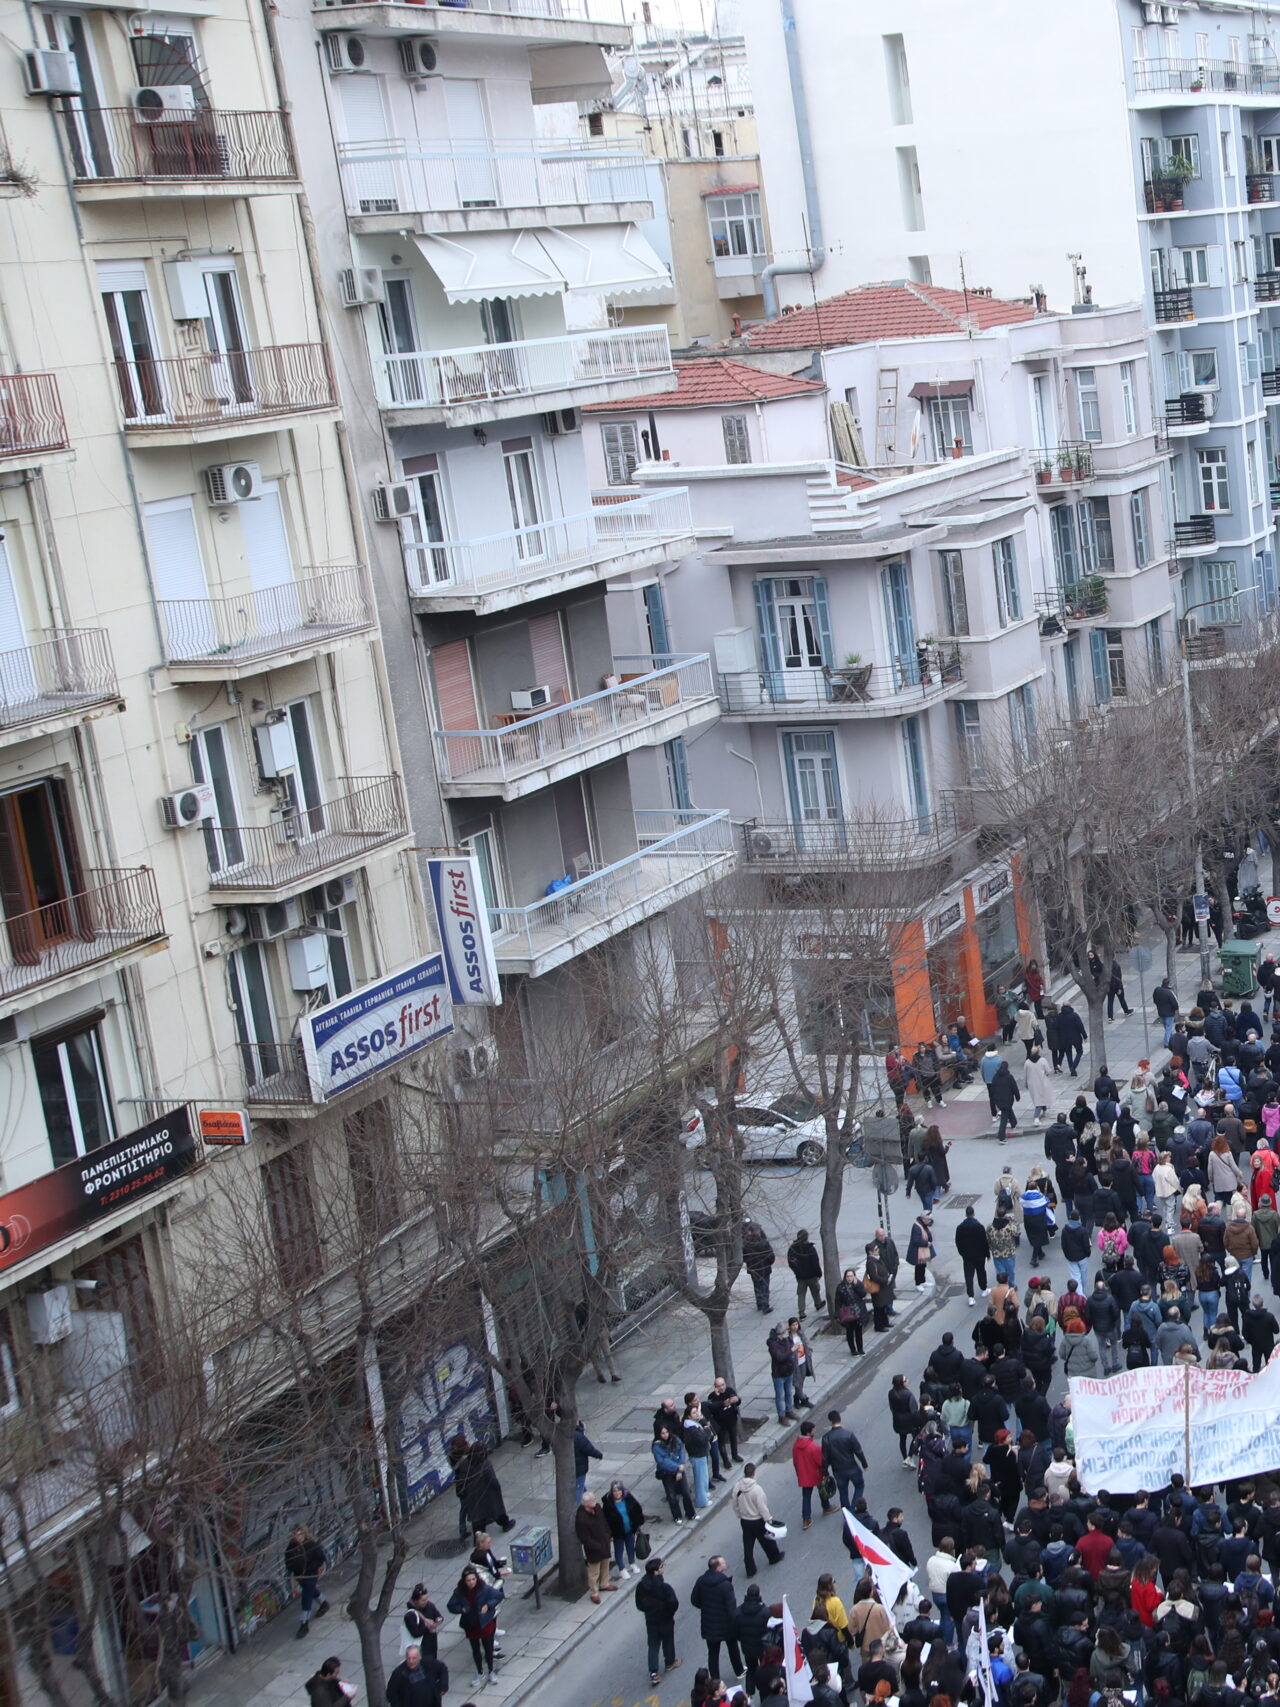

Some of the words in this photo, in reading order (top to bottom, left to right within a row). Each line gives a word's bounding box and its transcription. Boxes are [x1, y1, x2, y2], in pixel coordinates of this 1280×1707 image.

[448, 869, 476, 920] first
[460, 920, 484, 994] ASSOS
[330, 1020, 397, 1077] ASSOS
[398, 993, 441, 1048] first
[81, 1129, 169, 1181] ΠΑΝΕΠΙΣΤΗΜΙΑΚΟ
[84, 1142, 173, 1195] ΦΡΟΝΤΙΣΤΗΡΙΟ
